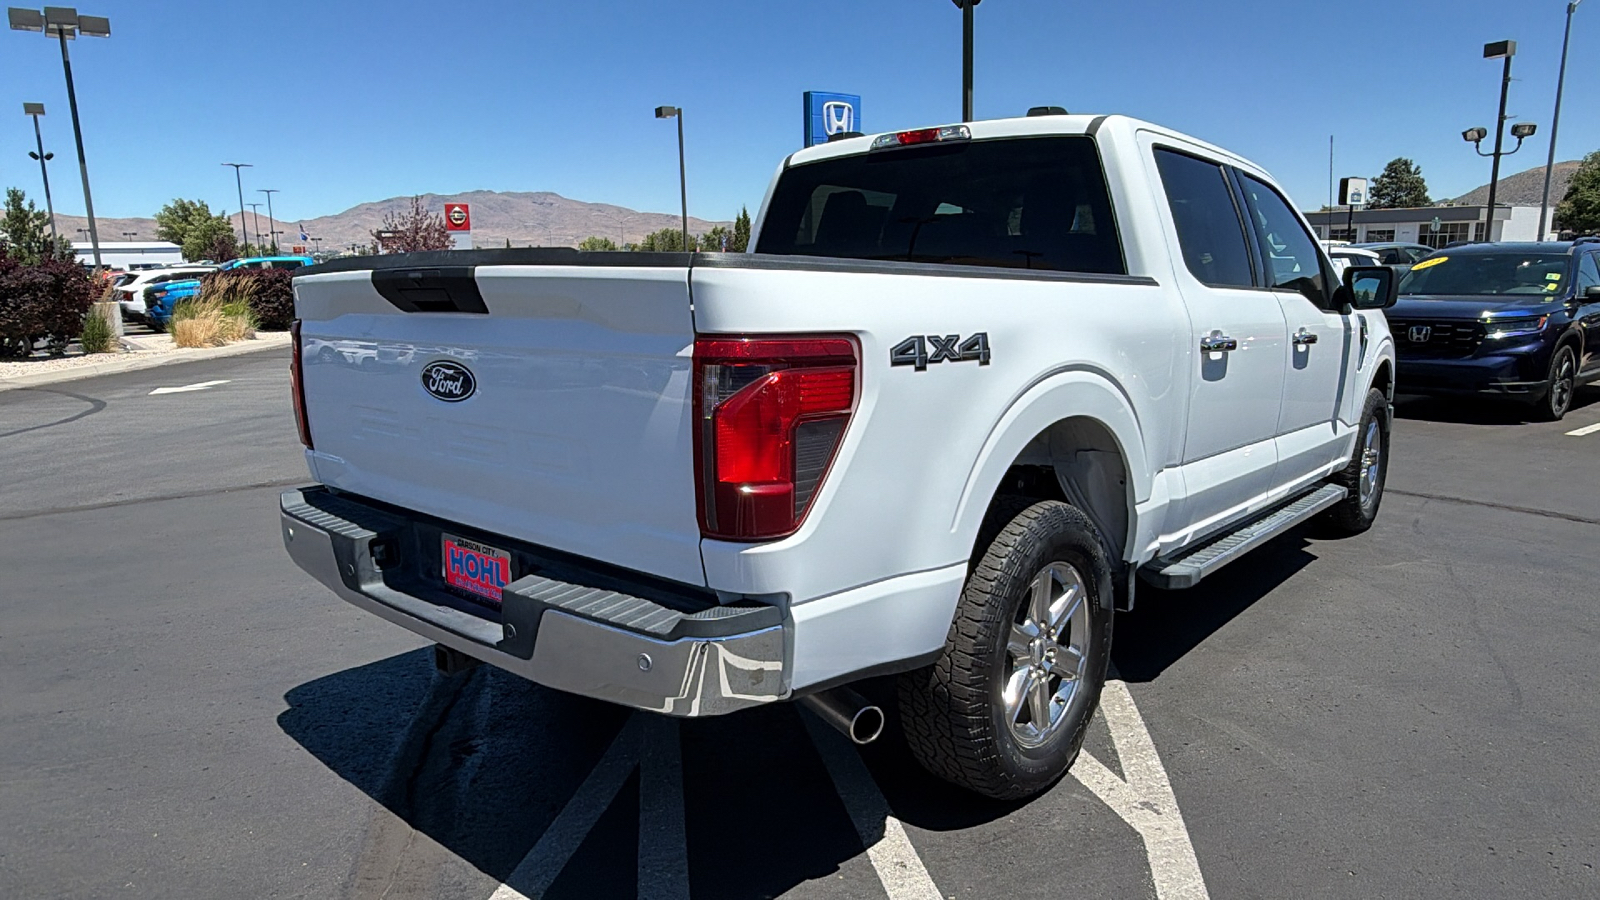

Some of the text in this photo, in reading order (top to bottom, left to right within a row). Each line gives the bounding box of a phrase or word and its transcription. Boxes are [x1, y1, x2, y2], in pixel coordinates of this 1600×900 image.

[429, 366, 464, 395] Ford
[457, 539, 496, 557] CARSON CITY
[449, 547, 506, 588] HOHL
